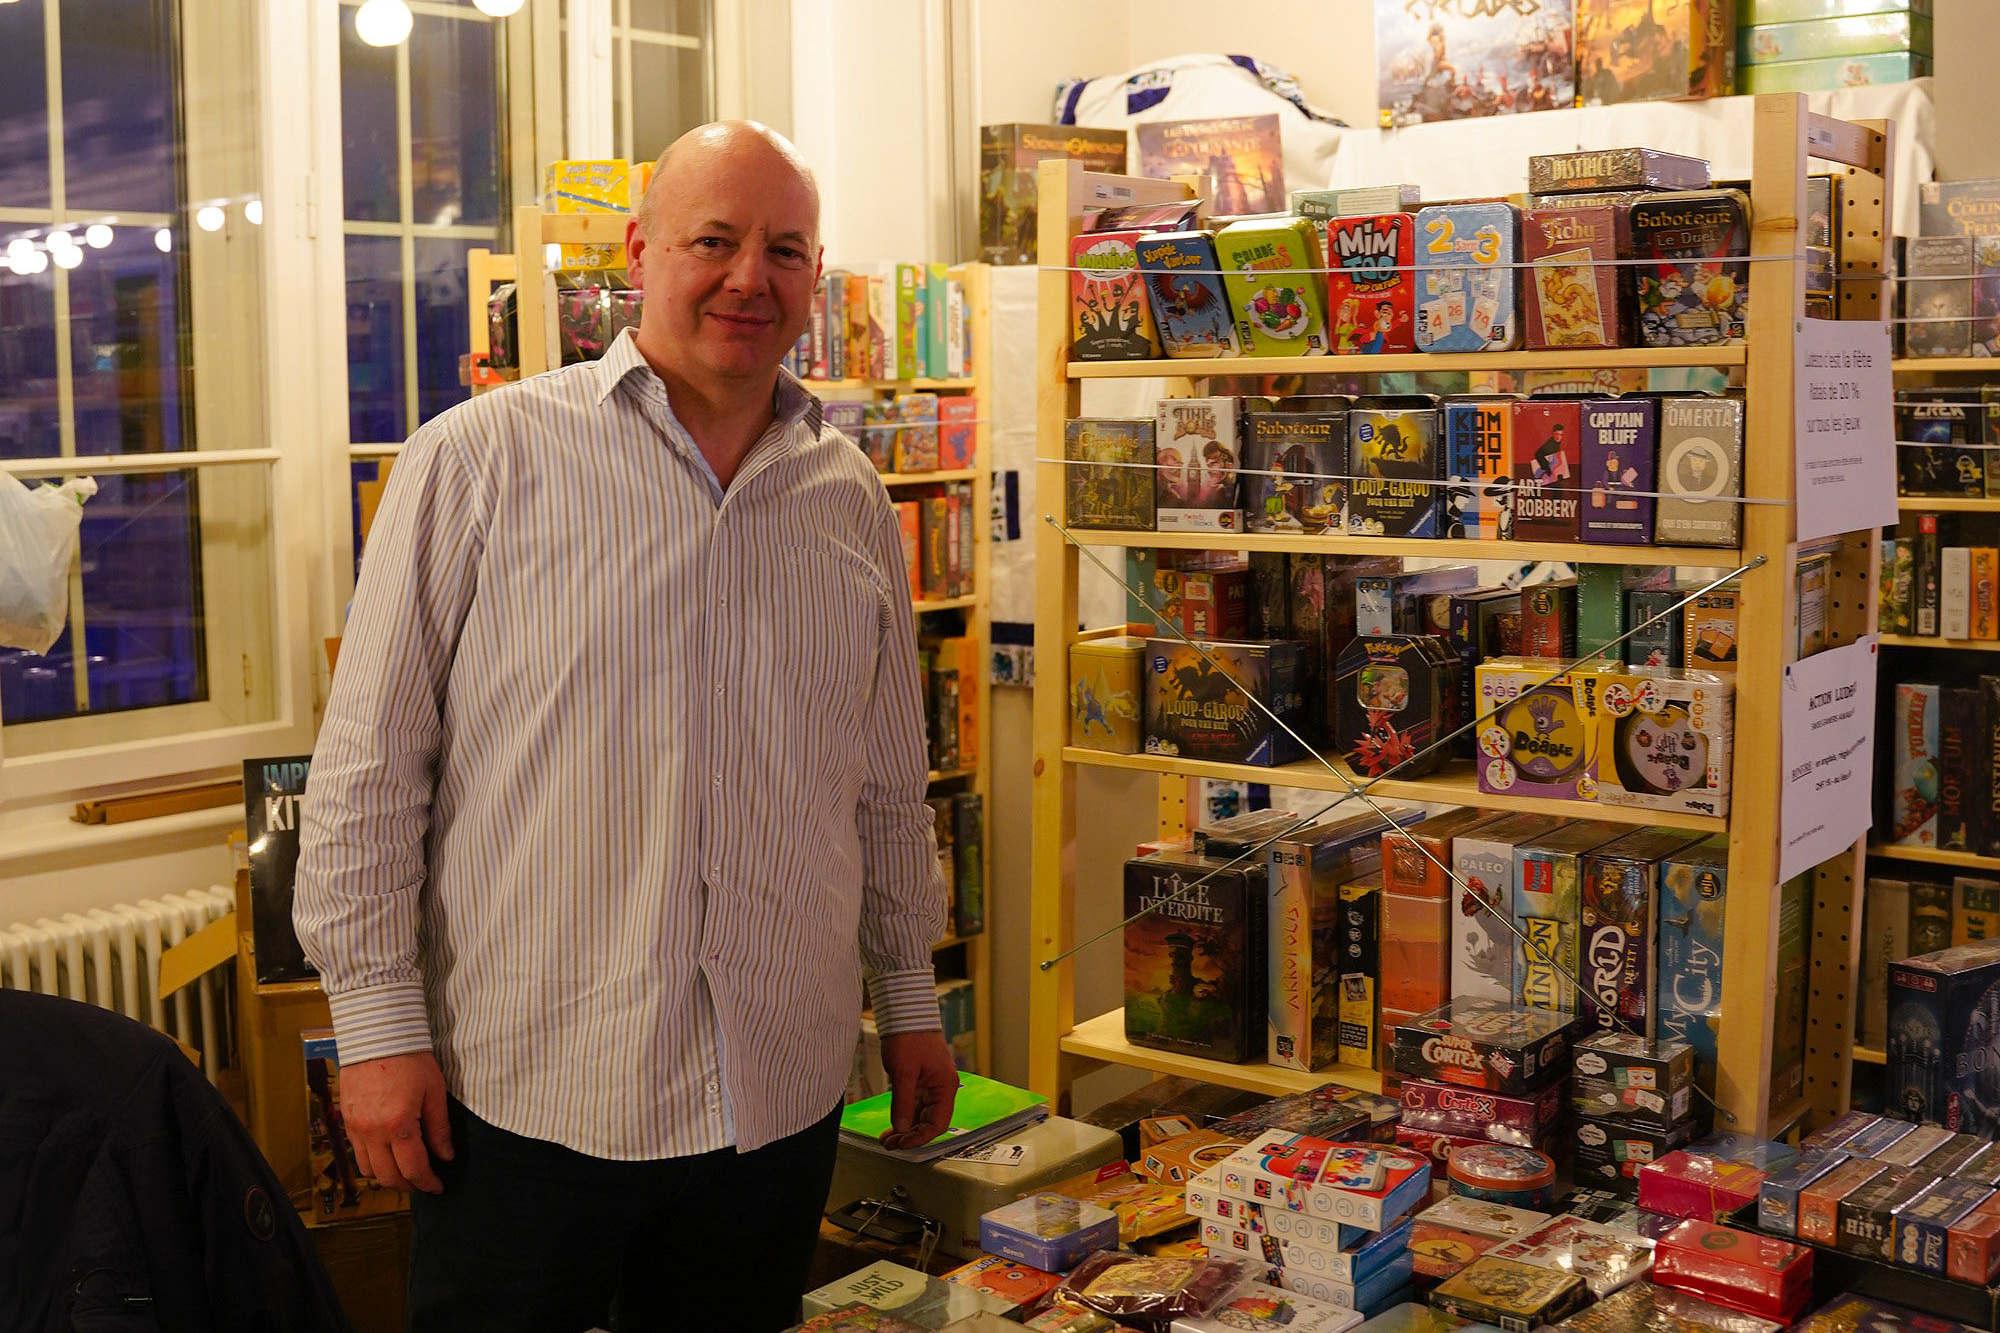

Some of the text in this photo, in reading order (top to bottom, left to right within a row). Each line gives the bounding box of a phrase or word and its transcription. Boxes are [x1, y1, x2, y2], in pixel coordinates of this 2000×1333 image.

[1553, 156, 1614, 180] DISTRICT
[1637, 211, 1732, 228] Saboteur
[1425, 217, 1455, 254] 2
[1471, 228, 1501, 264] 3
[1541, 217, 1595, 249] Tichu
[1657, 229, 1716, 246] Le Duel
[1076, 247, 1138, 269] UNANIMO
[1143, 242, 1176, 263] Stupide
[1164, 253, 1201, 269] Vautour
[1354, 275, 1402, 292] POP CULTURE
[1448, 305, 1463, 316] 26
[1432, 314, 1443, 329] 4
[1839, 382, 1849, 399] 20
[1257, 420, 1330, 435] Saboteur
[1455, 411, 1501, 431] KOM
[1589, 412, 1644, 428] CAPTAIN
[1668, 408, 1733, 428] OMERTA
[1599, 429, 1638, 445] BLUFF
[1456, 455, 1501, 475] MAT
[1352, 480, 1431, 499] LOUP-GAROU
[1517, 478, 1543, 497] ART
[1517, 499, 1578, 518] ROBBERY
[1166, 701, 1245, 722] LOUP-GAROU
[1514, 730, 1573, 757] DOBBLE
[1460, 858, 1504, 874] PALEO
[1139, 895, 1223, 923] INTERDITE
[1284, 908, 1299, 1010] AKROPOLIS
[1664, 939, 1721, 1044] My City
[1422, 1038, 1484, 1069] CORTEX
[1441, 1035, 1474, 1052] SUPER
[847, 1274, 887, 1294] JUST
[862, 1280, 905, 1301] WILD
